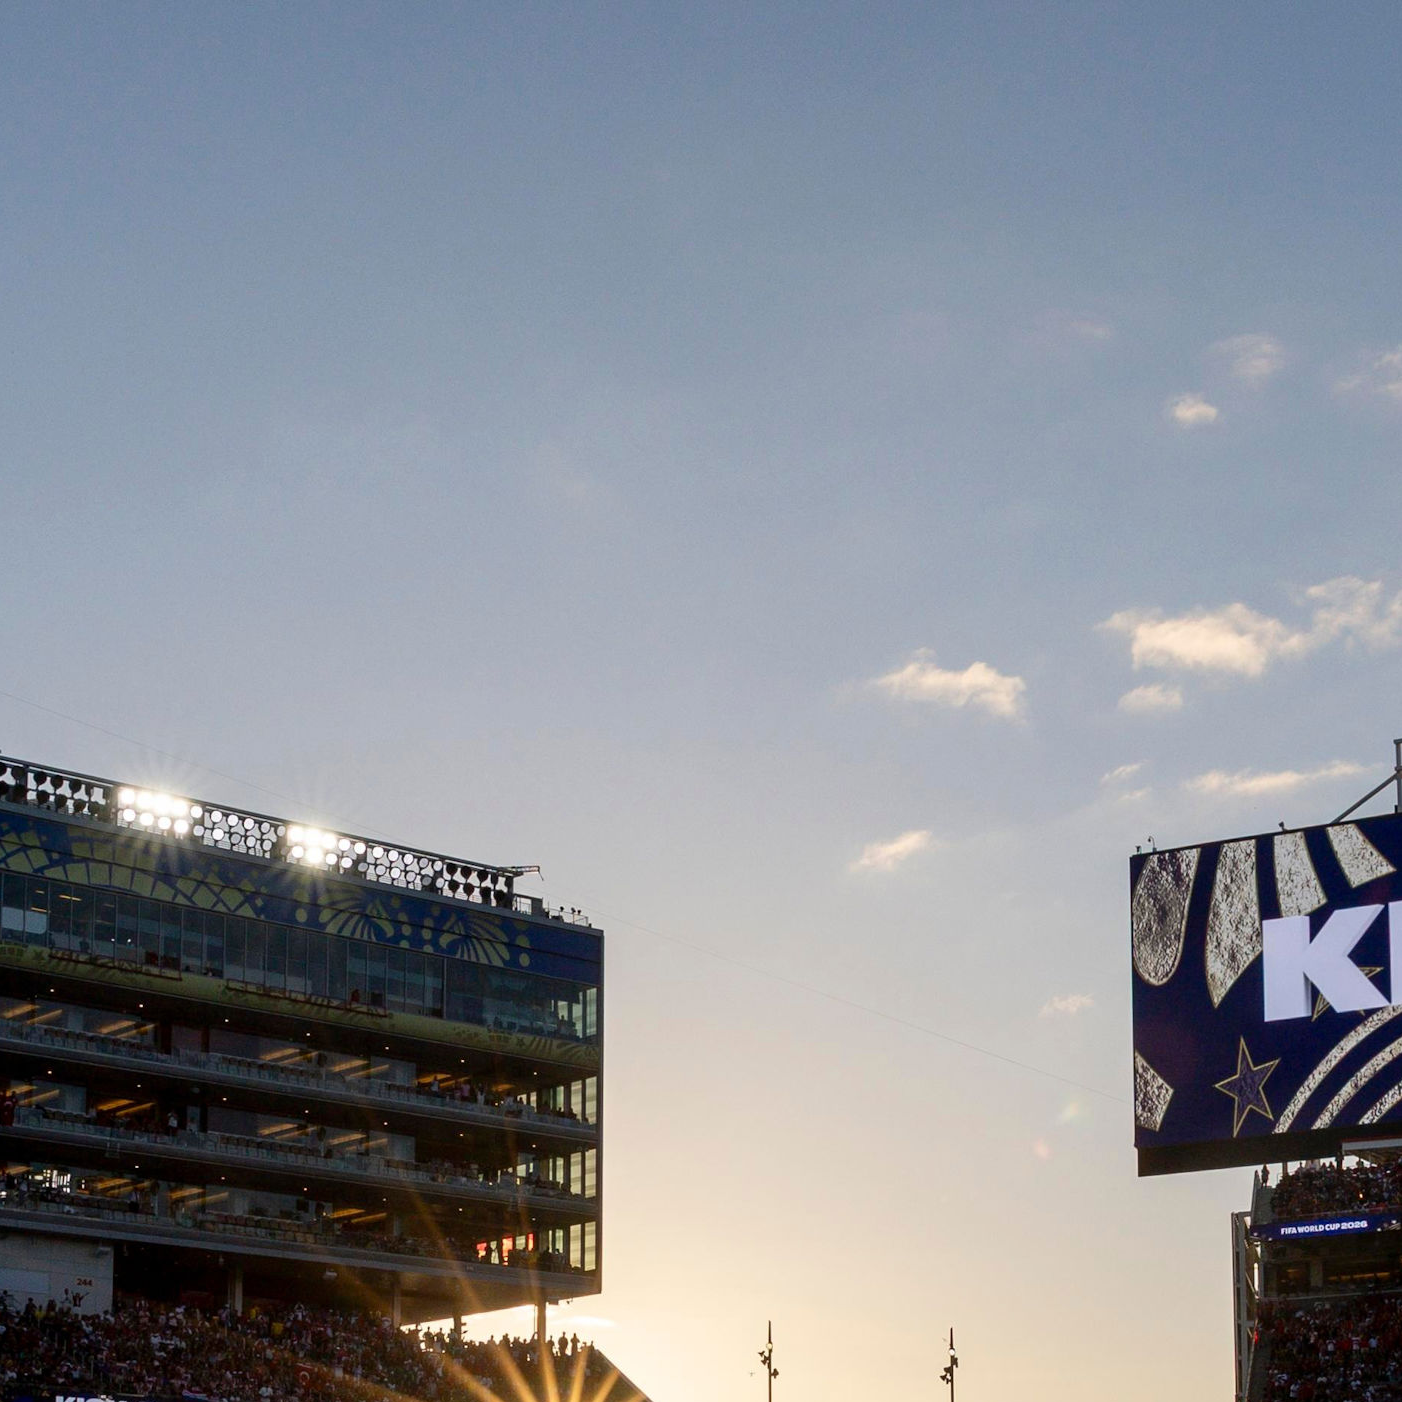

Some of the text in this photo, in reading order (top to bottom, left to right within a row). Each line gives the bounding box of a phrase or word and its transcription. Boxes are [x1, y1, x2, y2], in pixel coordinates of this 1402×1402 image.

[1281, 1220, 1368, 1235] FIFA WORLD CUP 2026
